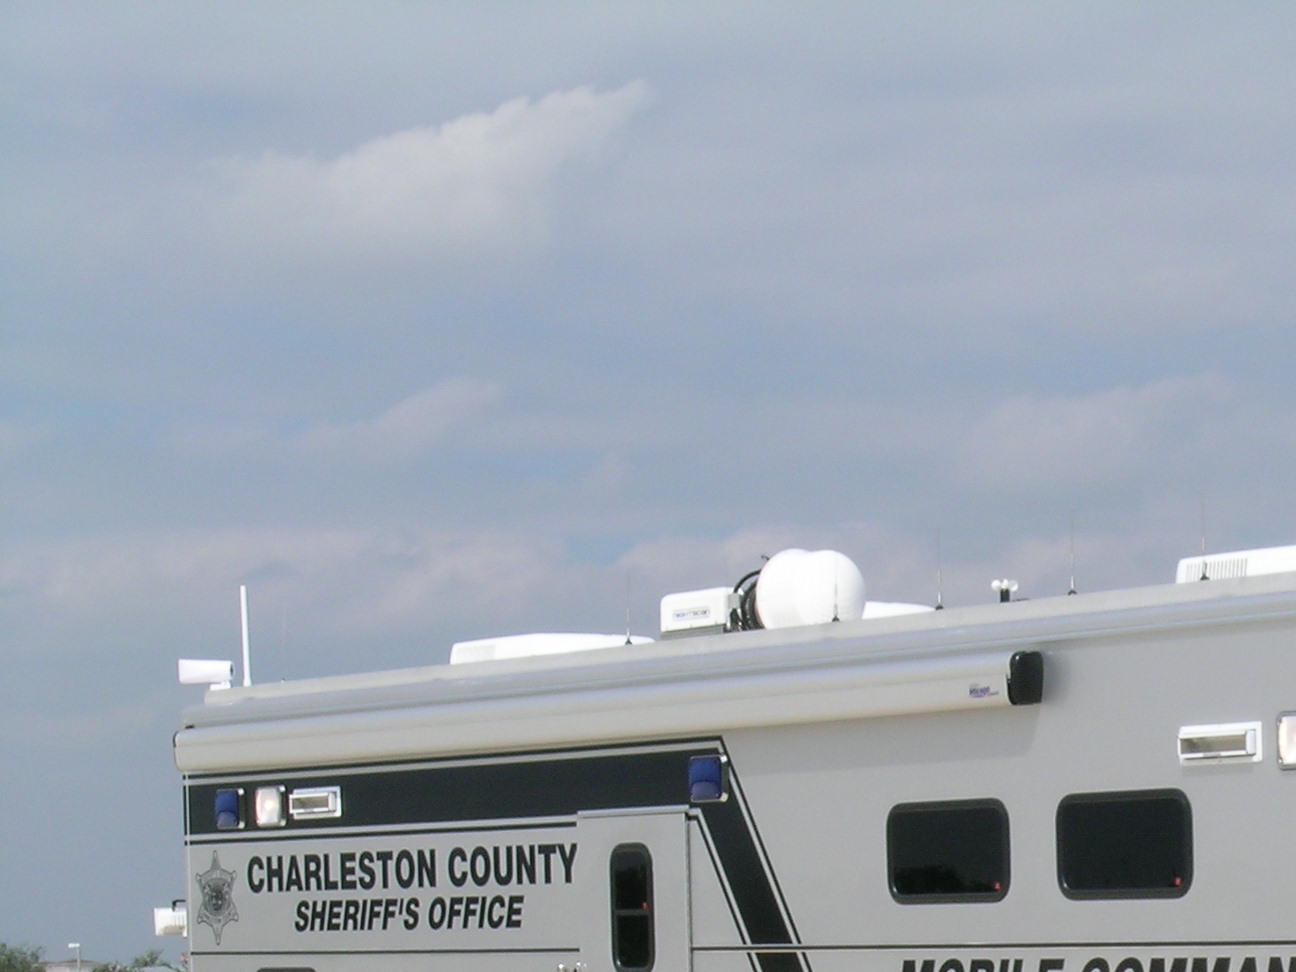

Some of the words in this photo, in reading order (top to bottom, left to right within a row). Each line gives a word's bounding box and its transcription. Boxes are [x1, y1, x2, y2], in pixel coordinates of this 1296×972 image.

[247, 848, 437, 894] CHARLESTON
[447, 843, 577, 888] COUNTY
[294, 897, 420, 932] SHERIFF'S
[428, 895, 525, 930] OFFICE
